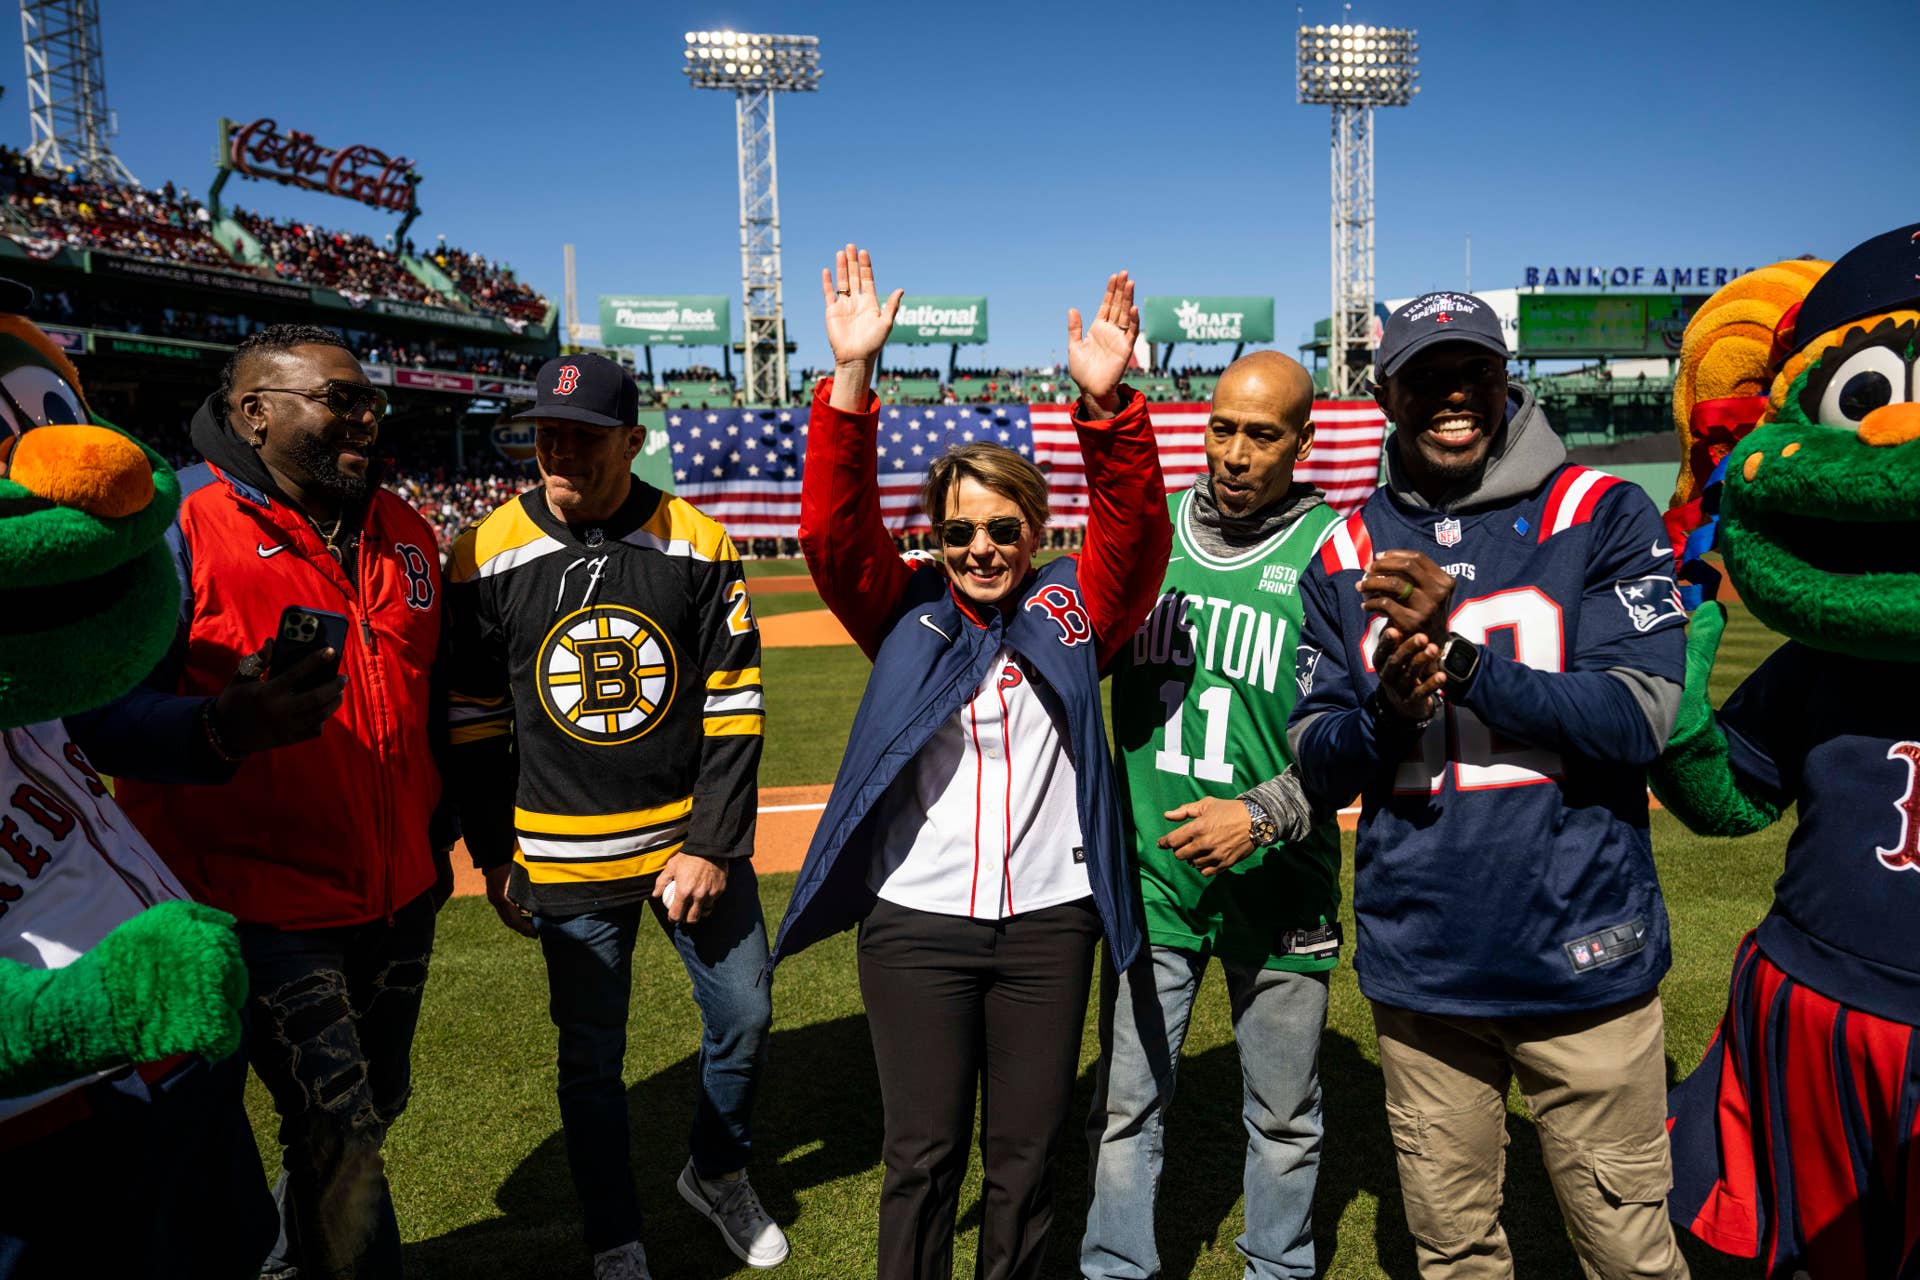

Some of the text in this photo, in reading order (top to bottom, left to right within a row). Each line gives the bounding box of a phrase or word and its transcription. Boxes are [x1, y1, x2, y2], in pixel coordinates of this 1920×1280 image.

[1525, 267, 1602, 286] BANK
[1610, 267, 1645, 286] OF
[1403, 293, 1450, 317] FENWAY
[1411, 302, 1474, 321] OPENING DAY
[615, 308, 715, 326] Plymouth Rock
[1178, 312, 1244, 330] DRAFT
[918, 327, 975, 336] Car Rental
[1186, 326, 1242, 339] KINGS
[552, 365, 581, 395] B
[1439, 530, 1458, 544] NFL
[394, 542, 434, 610] B
[1262, 564, 1298, 584] VISTA
[1258, 579, 1295, 596] PRINT
[722, 579, 758, 636] 2
[1025, 584, 1092, 647] B
[573, 635, 642, 716] B
[1155, 680, 1234, 784] 11
